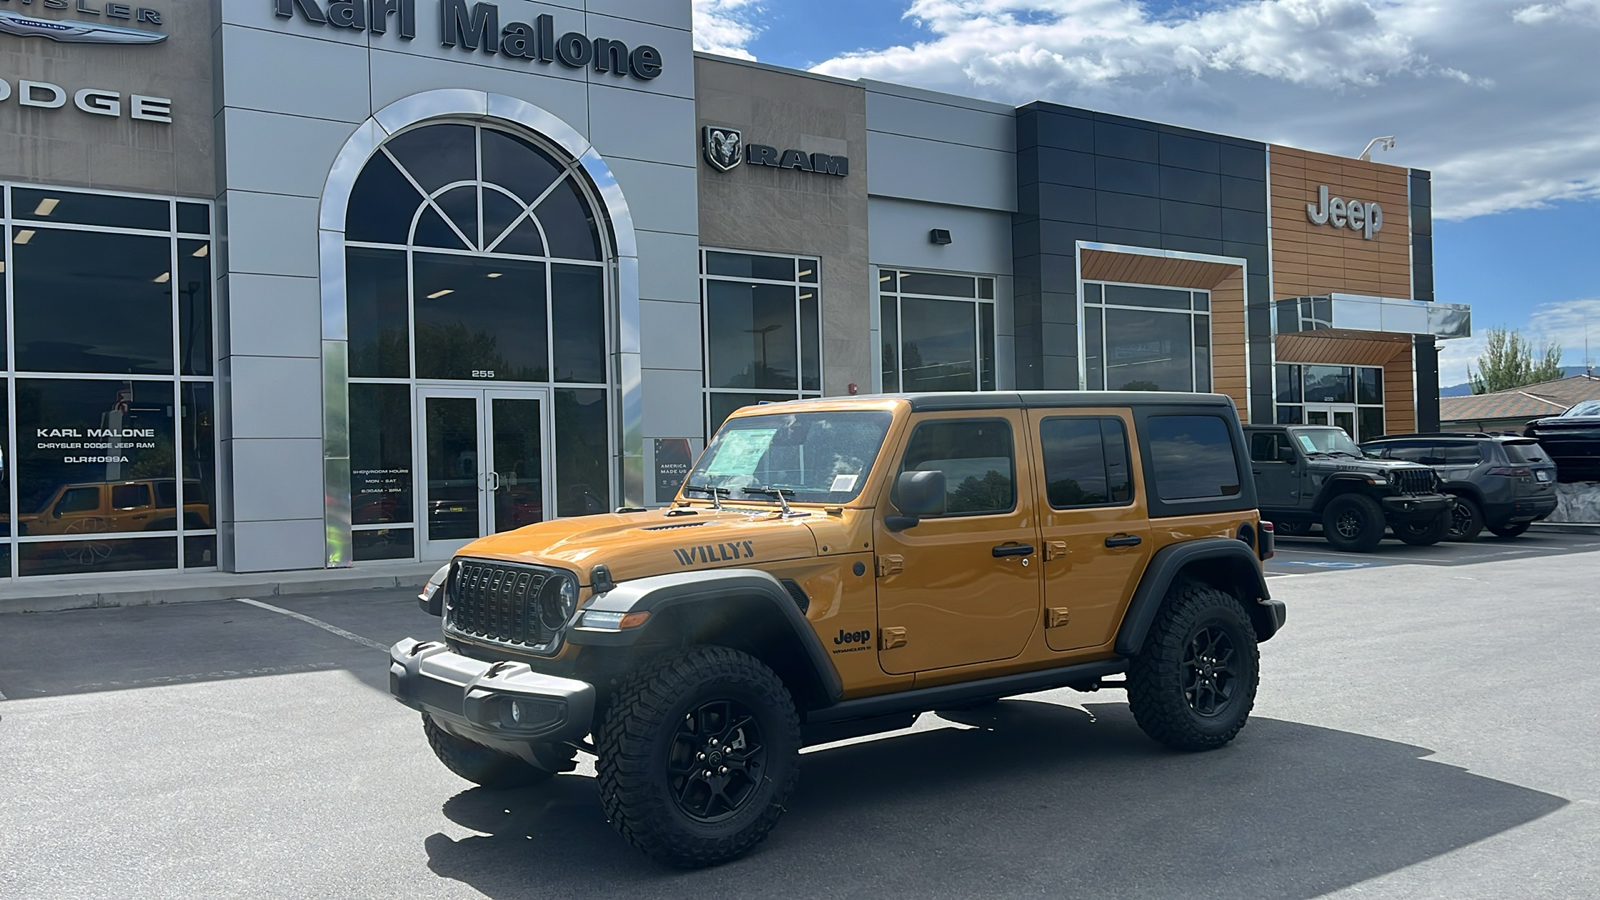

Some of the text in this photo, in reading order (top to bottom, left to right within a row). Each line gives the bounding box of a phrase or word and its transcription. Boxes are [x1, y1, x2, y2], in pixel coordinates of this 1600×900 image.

[14, 19, 66, 30] CHRYSLER
[440, 0, 663, 80] Malone
[0, 78, 172, 124] DGE
[746, 143, 849, 177] RAM
[1306, 185, 1383, 240] Jeep
[471, 370, 495, 378] 255
[37, 428, 155, 438] KARL MALONE
[673, 540, 754, 566] WILLYS
[833, 629, 871, 645] Jeep
[832, 646, 866, 654] WRANGLER
